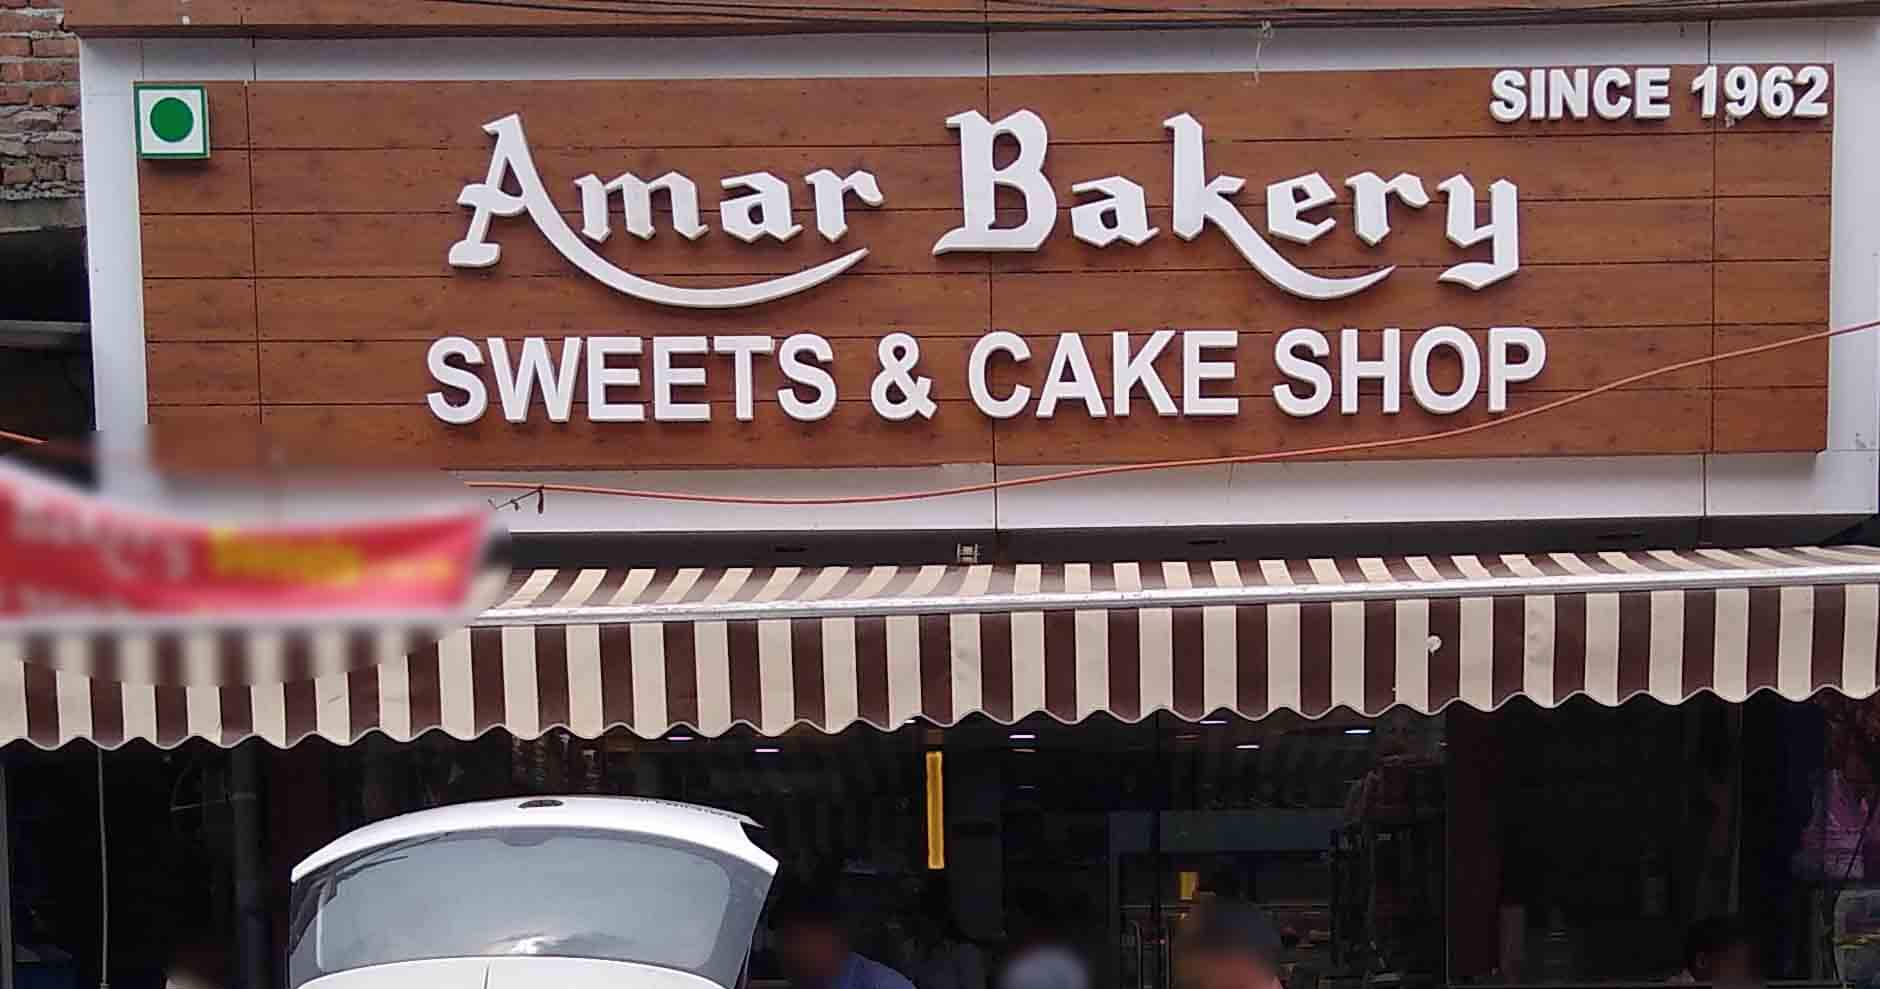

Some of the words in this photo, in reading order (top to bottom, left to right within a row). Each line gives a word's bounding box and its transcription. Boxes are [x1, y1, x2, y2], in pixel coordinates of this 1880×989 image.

[1490, 67, 1671, 122] SINCE
[1691, 65, 1829, 119] 1962
[448, 113, 884, 307] Amar
[932, 109, 1520, 300] Bakery
[427, 334, 836, 423] SWEETS
[871, 333, 937, 419] &
[969, 330, 1239, 417] CAKE
[1272, 326, 1546, 415] SHOP
